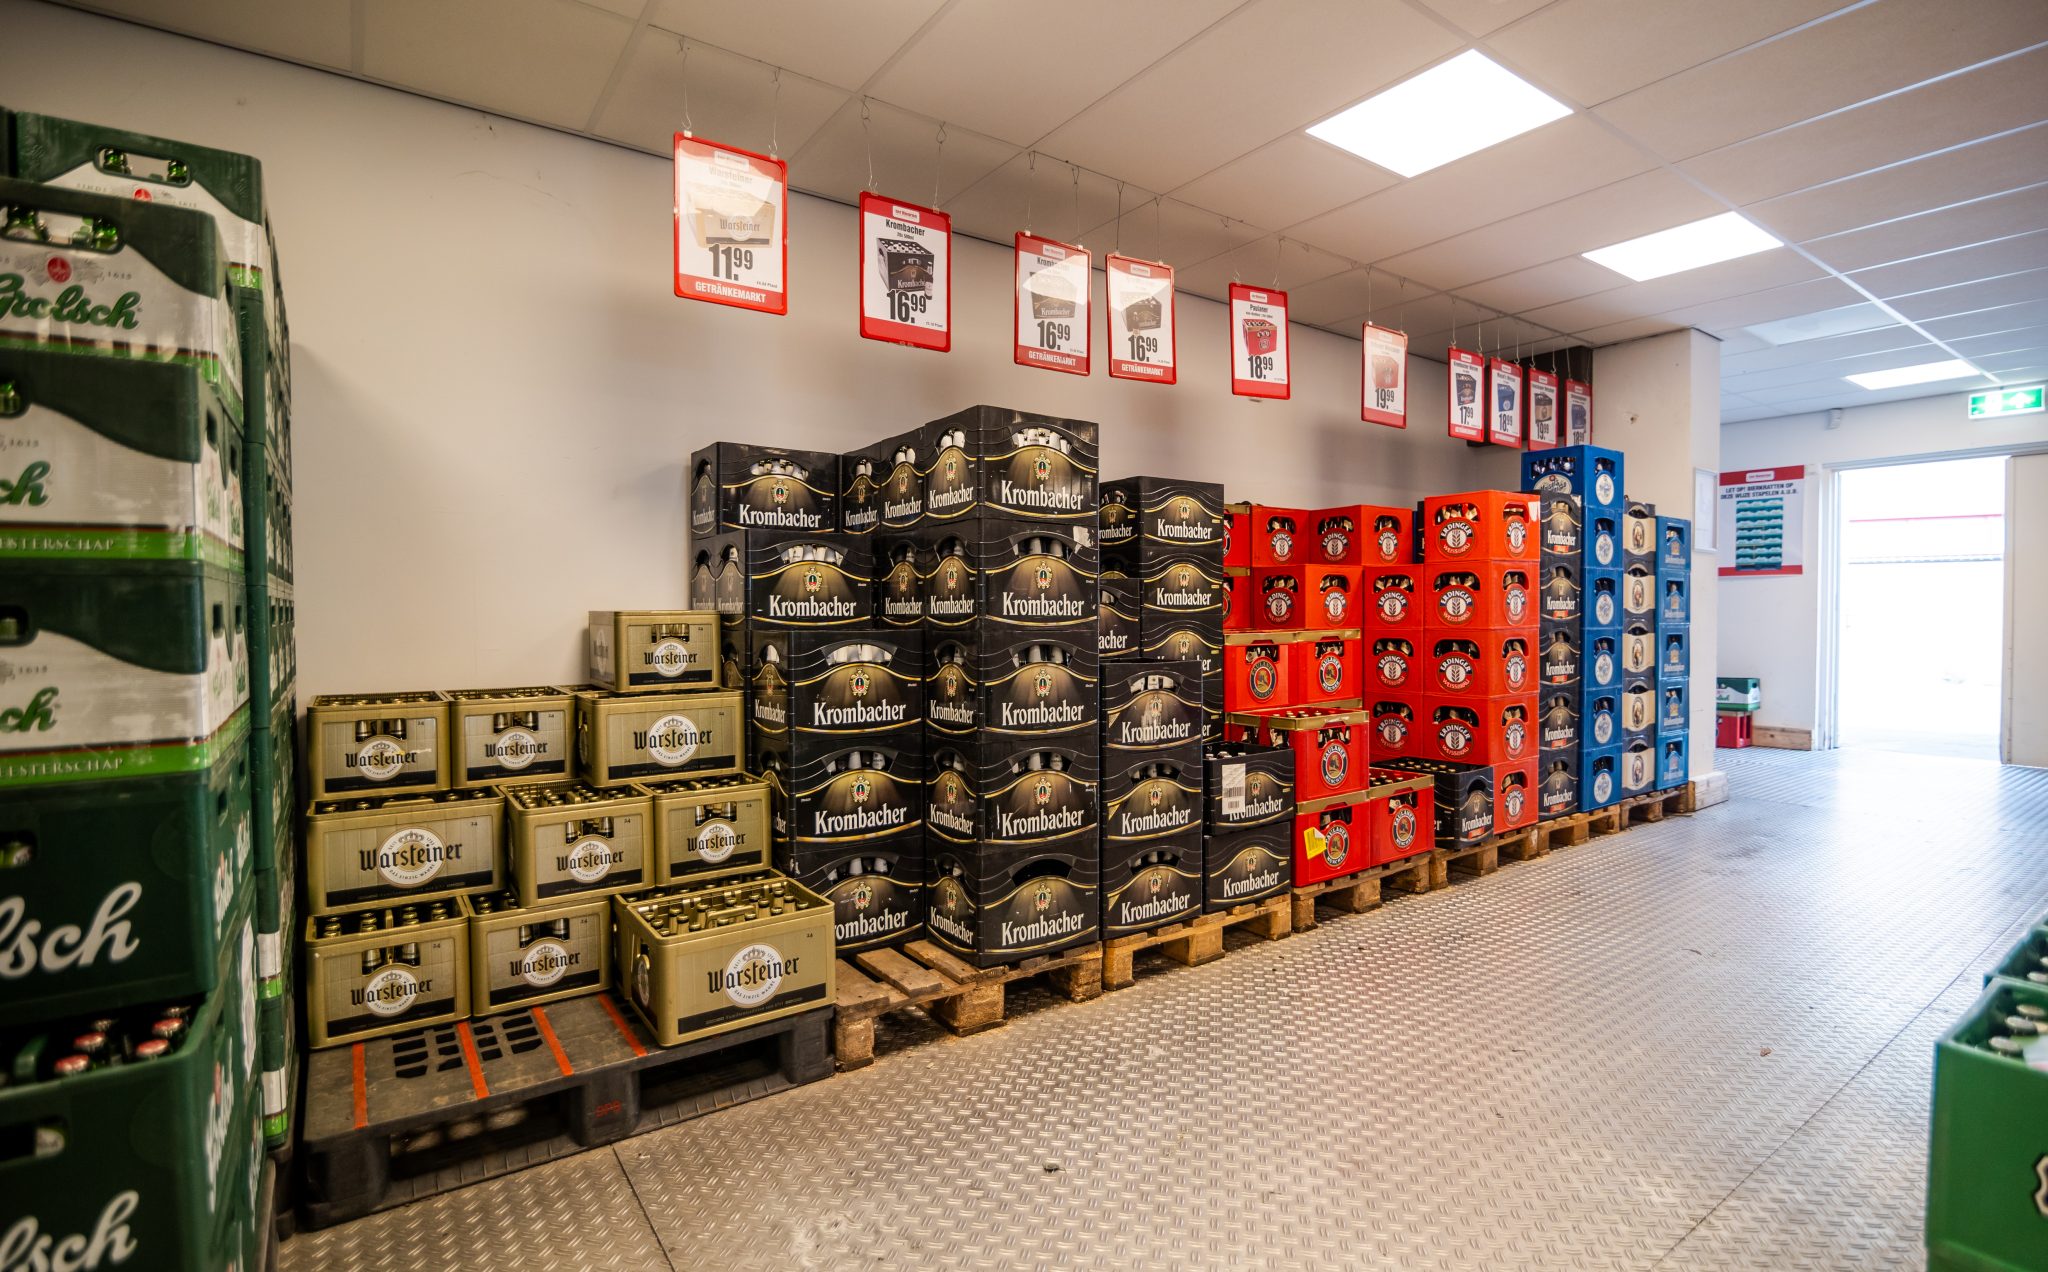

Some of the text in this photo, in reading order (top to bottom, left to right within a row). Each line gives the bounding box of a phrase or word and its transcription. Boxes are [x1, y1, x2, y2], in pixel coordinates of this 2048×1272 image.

[885, 218, 925, 237] Krombacher
[695, 281, 767, 303] GETRÄNKEMARKT
[1028, 350, 1077, 367] GETRÄNKEMARKT
[1121, 363, 1164, 377] GETRÄNKEMARKT
[929, 483, 974, 509] Krombacher
[1000, 480, 1084, 511] Krombacher
[739, 504, 822, 528] Krombacher
[845, 506, 878, 527] Krombacher
[884, 497, 922, 519] Krombacher
[1099, 523, 1133, 539] rombacher
[1157, 519, 1213, 540] Krombacher
[1271, 532, 1293, 547] ERDINGER
[1322, 532, 1348, 546] ERDINGER
[1377, 531, 1398, 545] ERDINGER
[1440, 522, 1473, 537] ERDINGER
[1547, 530, 1577, 546] Krombacher
[769, 595, 857, 617] Krombacher
[885, 596, 923, 615] Krombacher
[929, 594, 975, 614] Krombacher
[1002, 591, 1085, 616] Krombacher
[1156, 587, 1212, 606] Krombacher
[1266, 592, 1292, 606] ERDINGER
[1324, 591, 1346, 605] ERDINGER
[1378, 592, 1407, 605] ERDINGER
[1440, 590, 1472, 604] ERDINGER
[1546, 596, 1576, 610] Krombacher
[1098, 629, 1128, 650] acher
[644, 650, 699, 666] Warsteiner
[1378, 655, 1407, 668] ERDINGER
[1440, 657, 1472, 672] ERDINGER
[1545, 661, 1575, 676] Krombacher
[754, 699, 786, 724] Krombacher
[813, 699, 907, 726] Krombacher
[930, 700, 974, 725] Krombacher
[1001, 700, 1085, 726] Krombacher
[1121, 717, 1191, 744] Krombacher
[1378, 718, 1408, 733] ERDINGER
[1439, 725, 1472, 739] ERDINGER
[1544, 726, 1574, 742] Krombacher
[484, 741, 549, 758] Warsteiner
[633, 728, 713, 751] Warsteiner
[345, 749, 417, 769] Warsteiner
[1323, 745, 1346, 761] PAULANER
[1543, 789, 1573, 806] Krombacher
[814, 803, 908, 835] Krombacher
[930, 804, 974, 835] Krombacher
[1001, 805, 1085, 837] Krombacher
[1121, 805, 1191, 835] Krombacher
[1461, 812, 1493, 833] Krombacher
[686, 833, 747, 852] Warsteiner
[359, 843, 463, 872] Warsteiner
[556, 850, 624, 872] Warsteiner
[1223, 869, 1280, 898] Krombacher
[1121, 893, 1191, 925] Krombacher
[835, 908, 909, 941] ombacher
[930, 906, 974, 945] Krombacher
[1001, 910, 1085, 947] Krombacher
[509, 951, 581, 977] Warsteiner
[706, 956, 800, 994] Warsteiner
[350, 979, 433, 1006] Warsteiner
